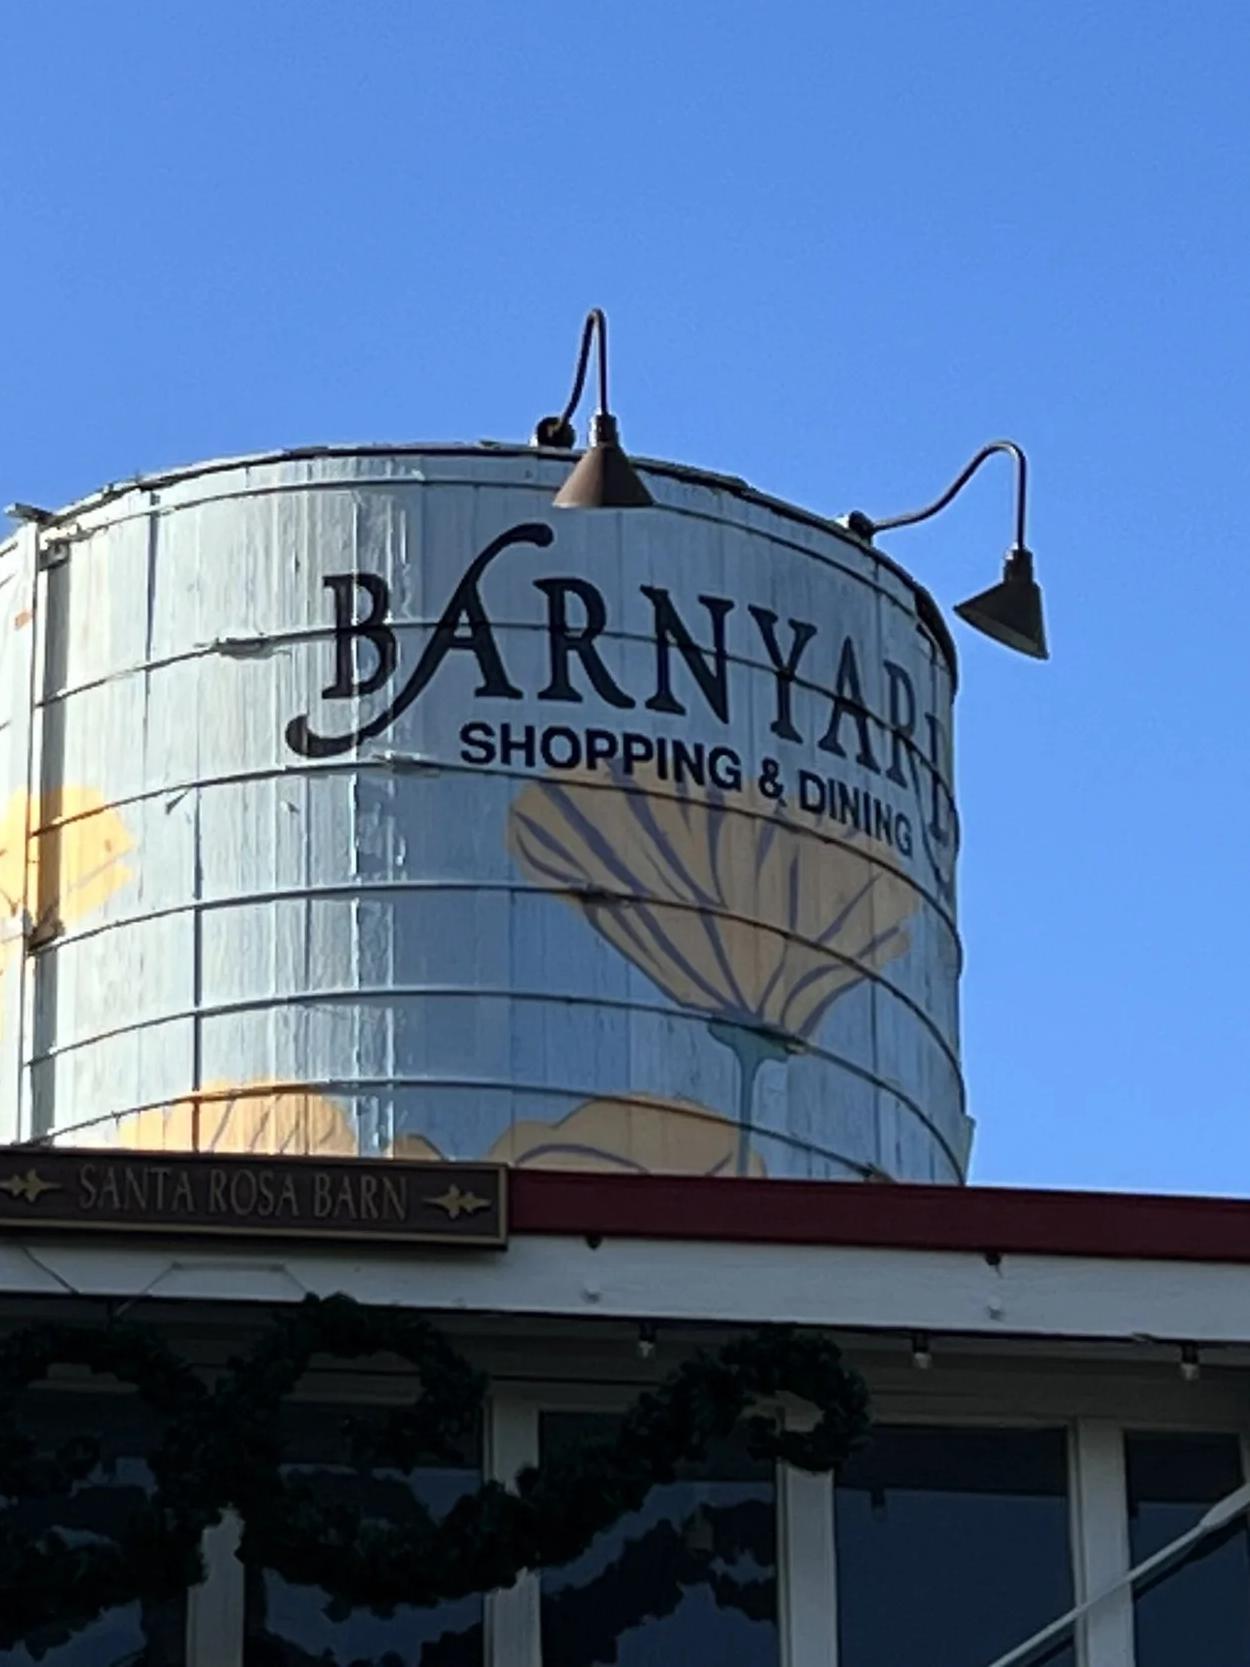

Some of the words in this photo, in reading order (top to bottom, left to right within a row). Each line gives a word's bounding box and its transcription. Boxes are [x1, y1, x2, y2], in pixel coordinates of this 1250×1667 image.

[459, 721, 743, 792] SHOPPING
[758, 757, 784, 798] &
[799, 769, 914, 859] DINING
[78, 1163, 196, 1210] SANTA
[208, 1167, 300, 1216] ROSA
[313, 1171, 406, 1220] BARN
